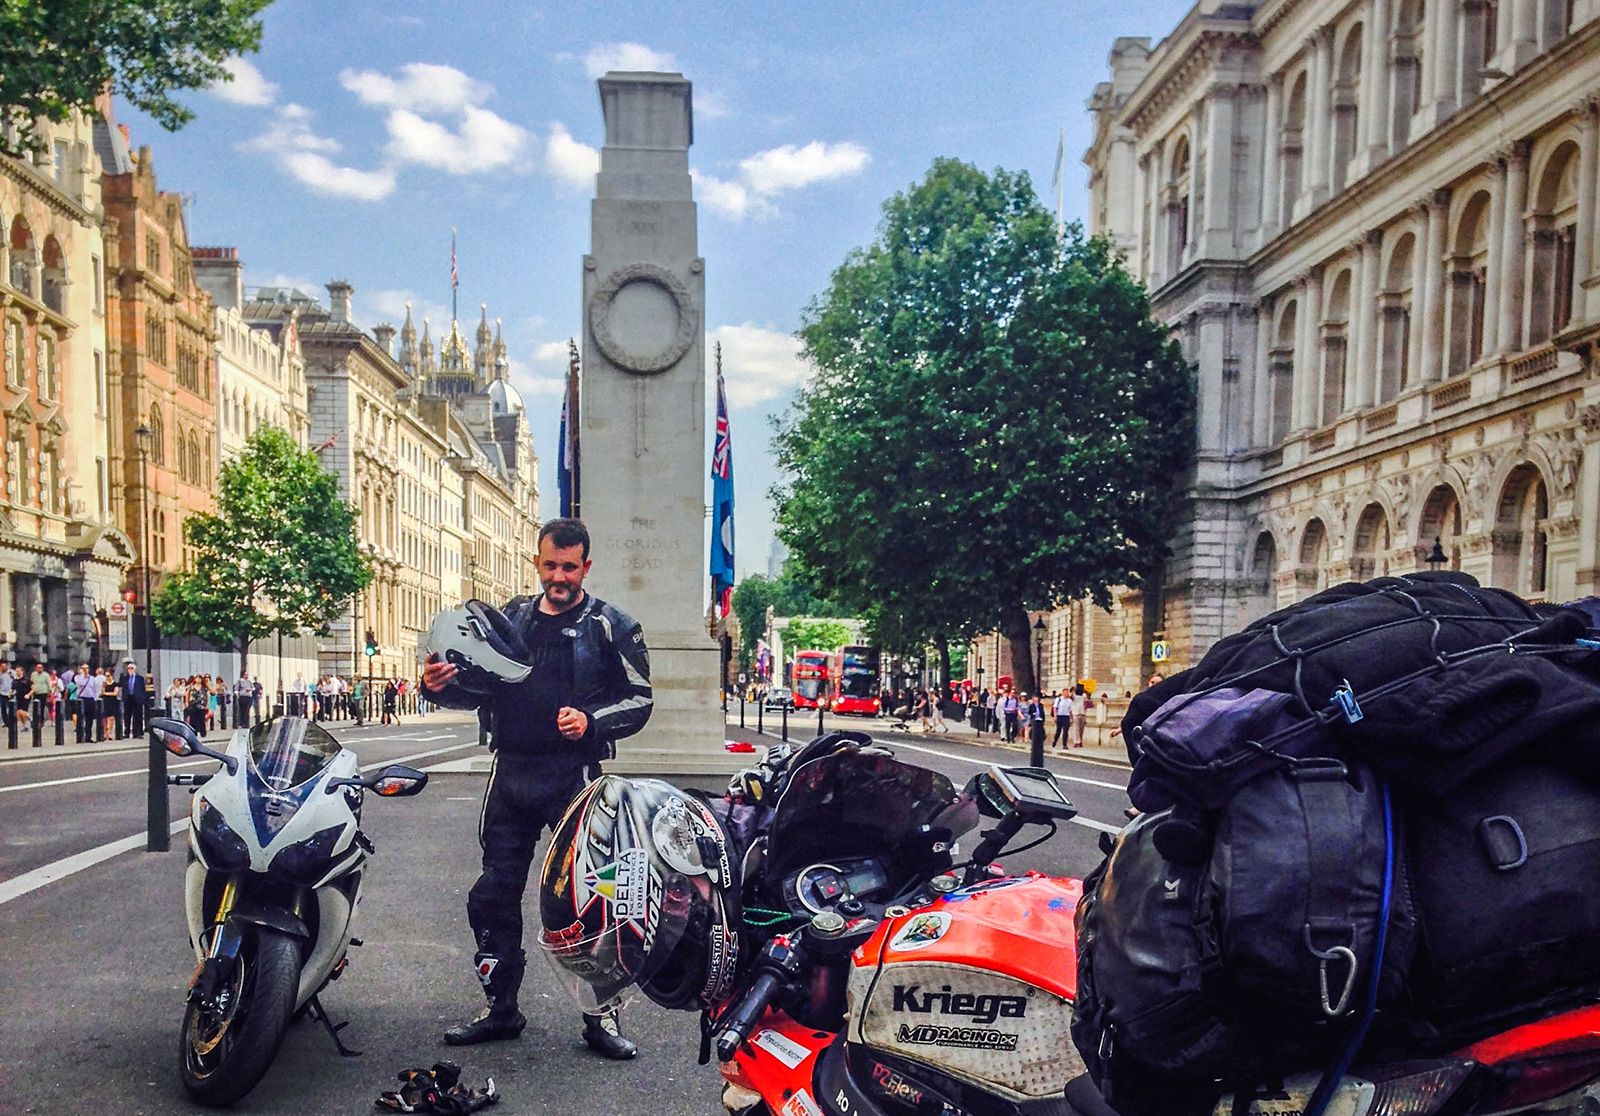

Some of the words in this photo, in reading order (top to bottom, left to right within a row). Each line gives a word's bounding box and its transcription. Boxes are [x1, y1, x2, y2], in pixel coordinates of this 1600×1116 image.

[260, 793, 289, 801] HONDA
[616, 852, 631, 916] DELTA
[637, 851, 646, 915] 1988-2013
[643, 863, 663, 956] SHOEI
[893, 985, 1027, 1024] Kriega
